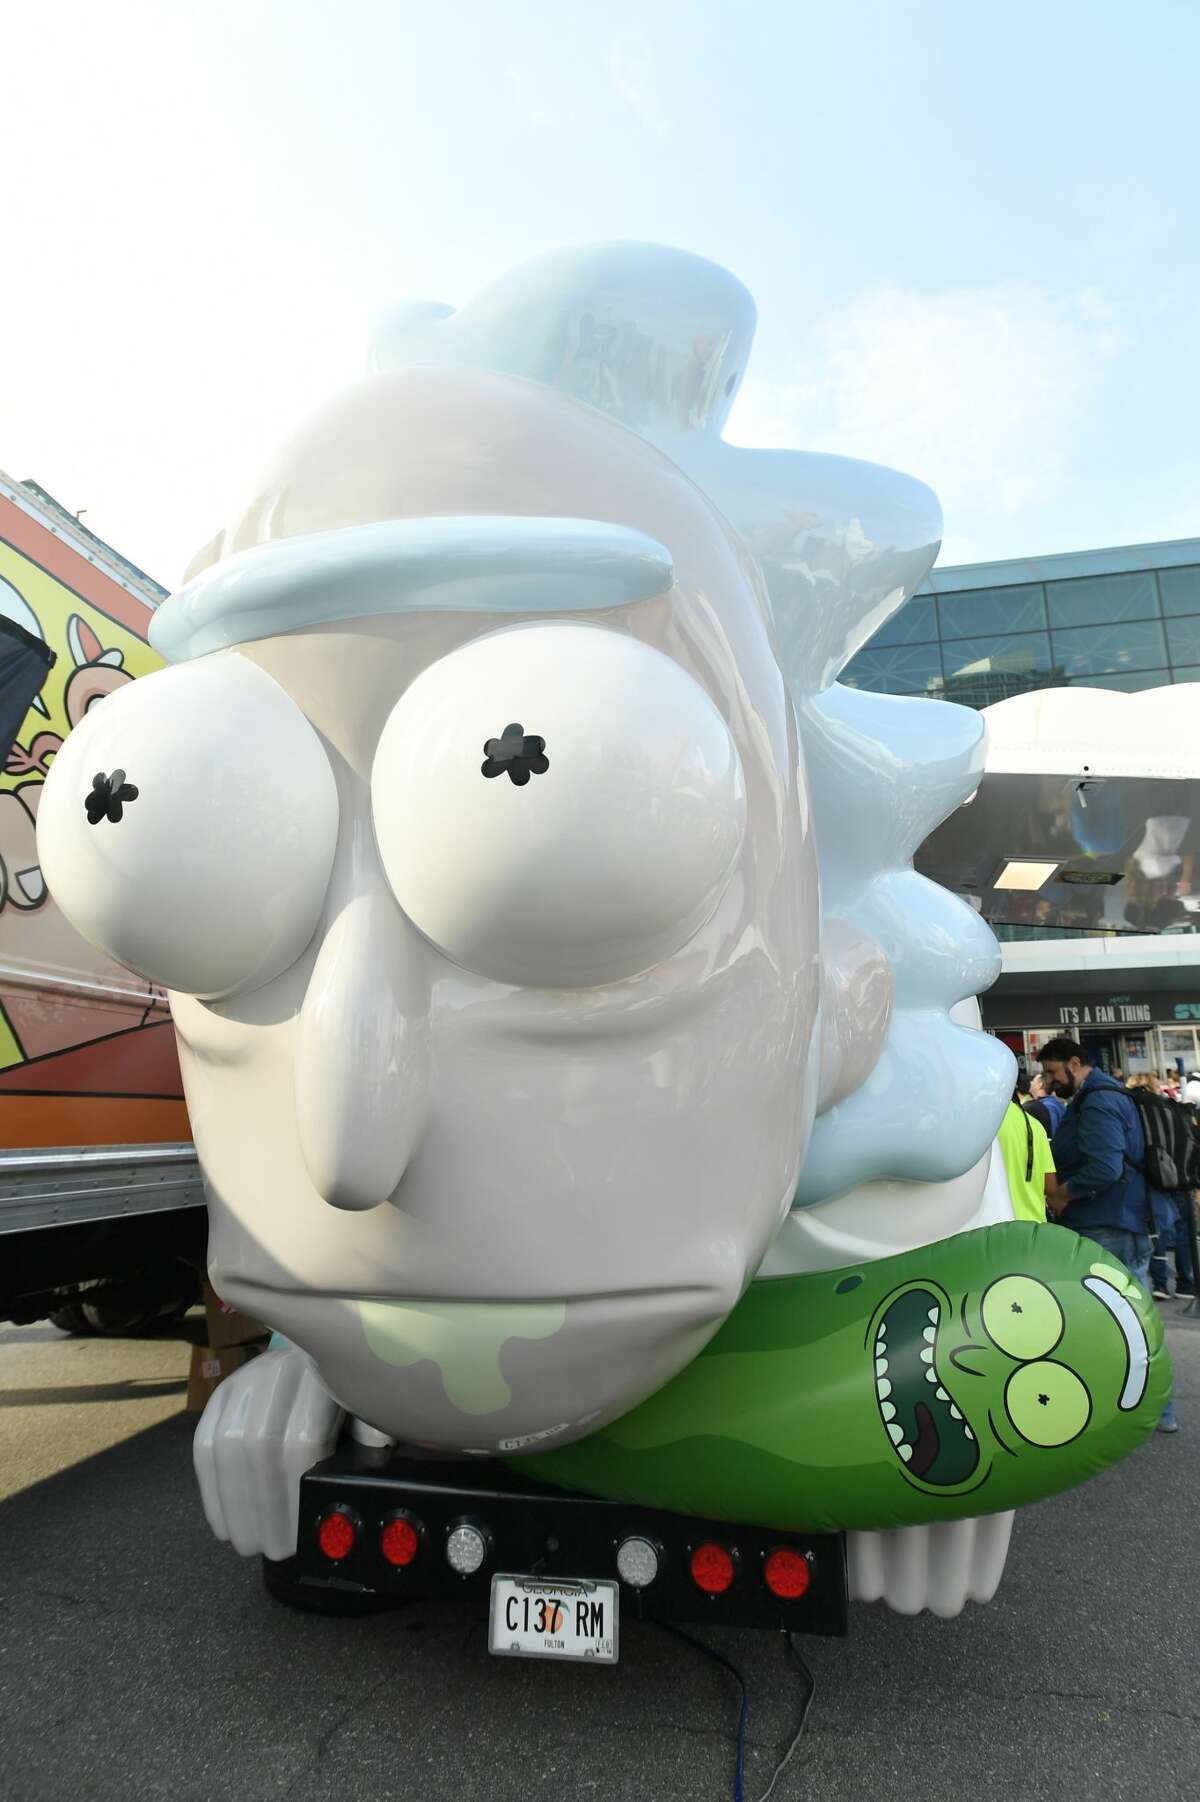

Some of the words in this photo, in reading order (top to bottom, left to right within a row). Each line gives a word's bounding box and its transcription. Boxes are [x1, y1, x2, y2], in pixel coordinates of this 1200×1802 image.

[1060, 1007, 1079, 1023] IT'S
[1084, 1006, 1092, 1022] A
[1095, 1006, 1115, 1022] FAN
[1120, 1004, 1151, 1021] THING
[506, 1596, 561, 1634] C137
[576, 1601, 604, 1638] RM
[544, 1639, 565, 1649] FULTON
